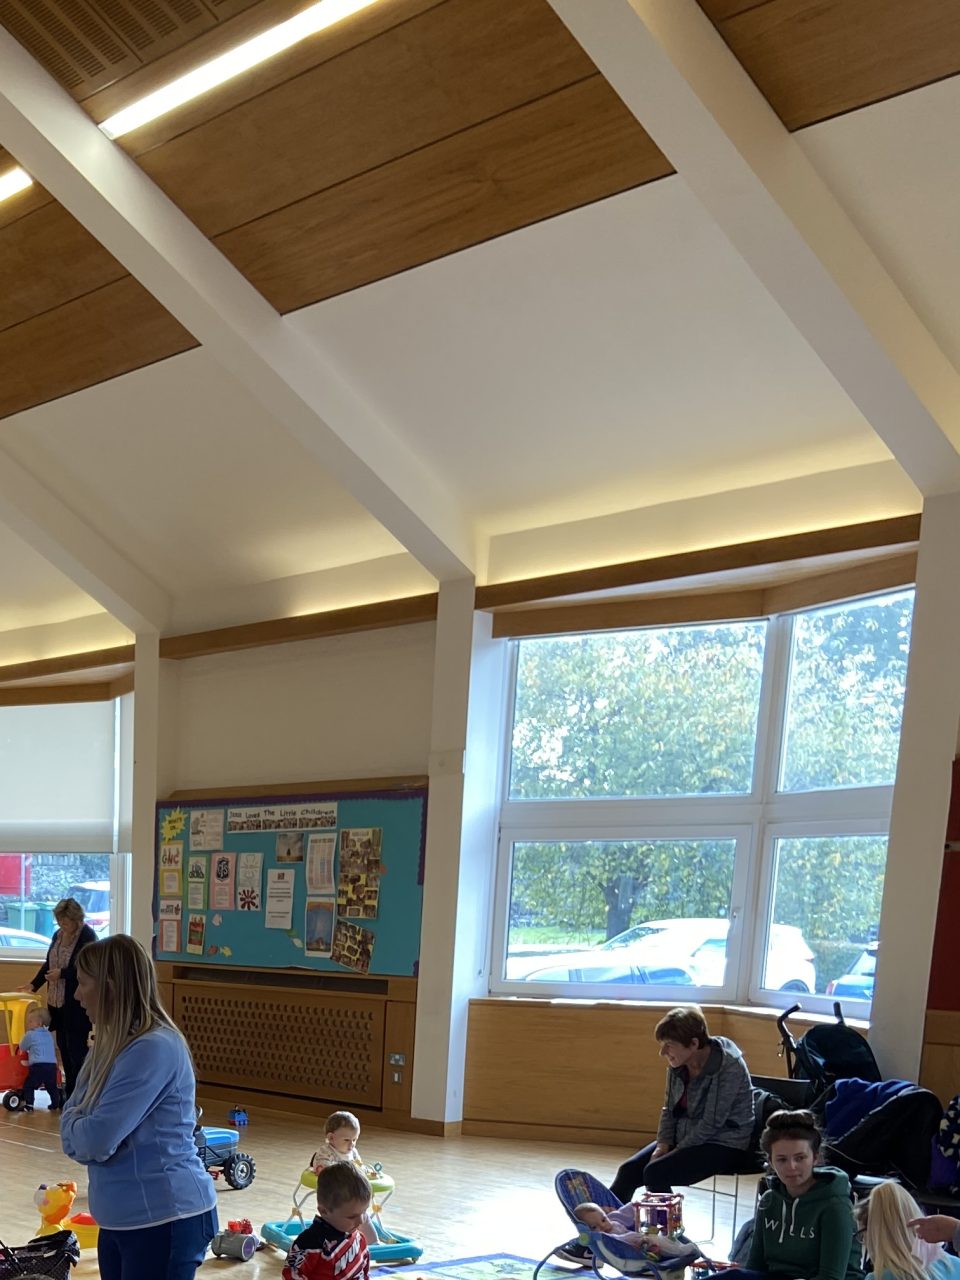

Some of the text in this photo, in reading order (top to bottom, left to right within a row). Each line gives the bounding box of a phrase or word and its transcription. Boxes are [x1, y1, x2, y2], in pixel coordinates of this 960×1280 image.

[264, 808, 275, 817] The
[280, 808, 297, 817] Little
[765, 1217, 815, 1238] WLLS
